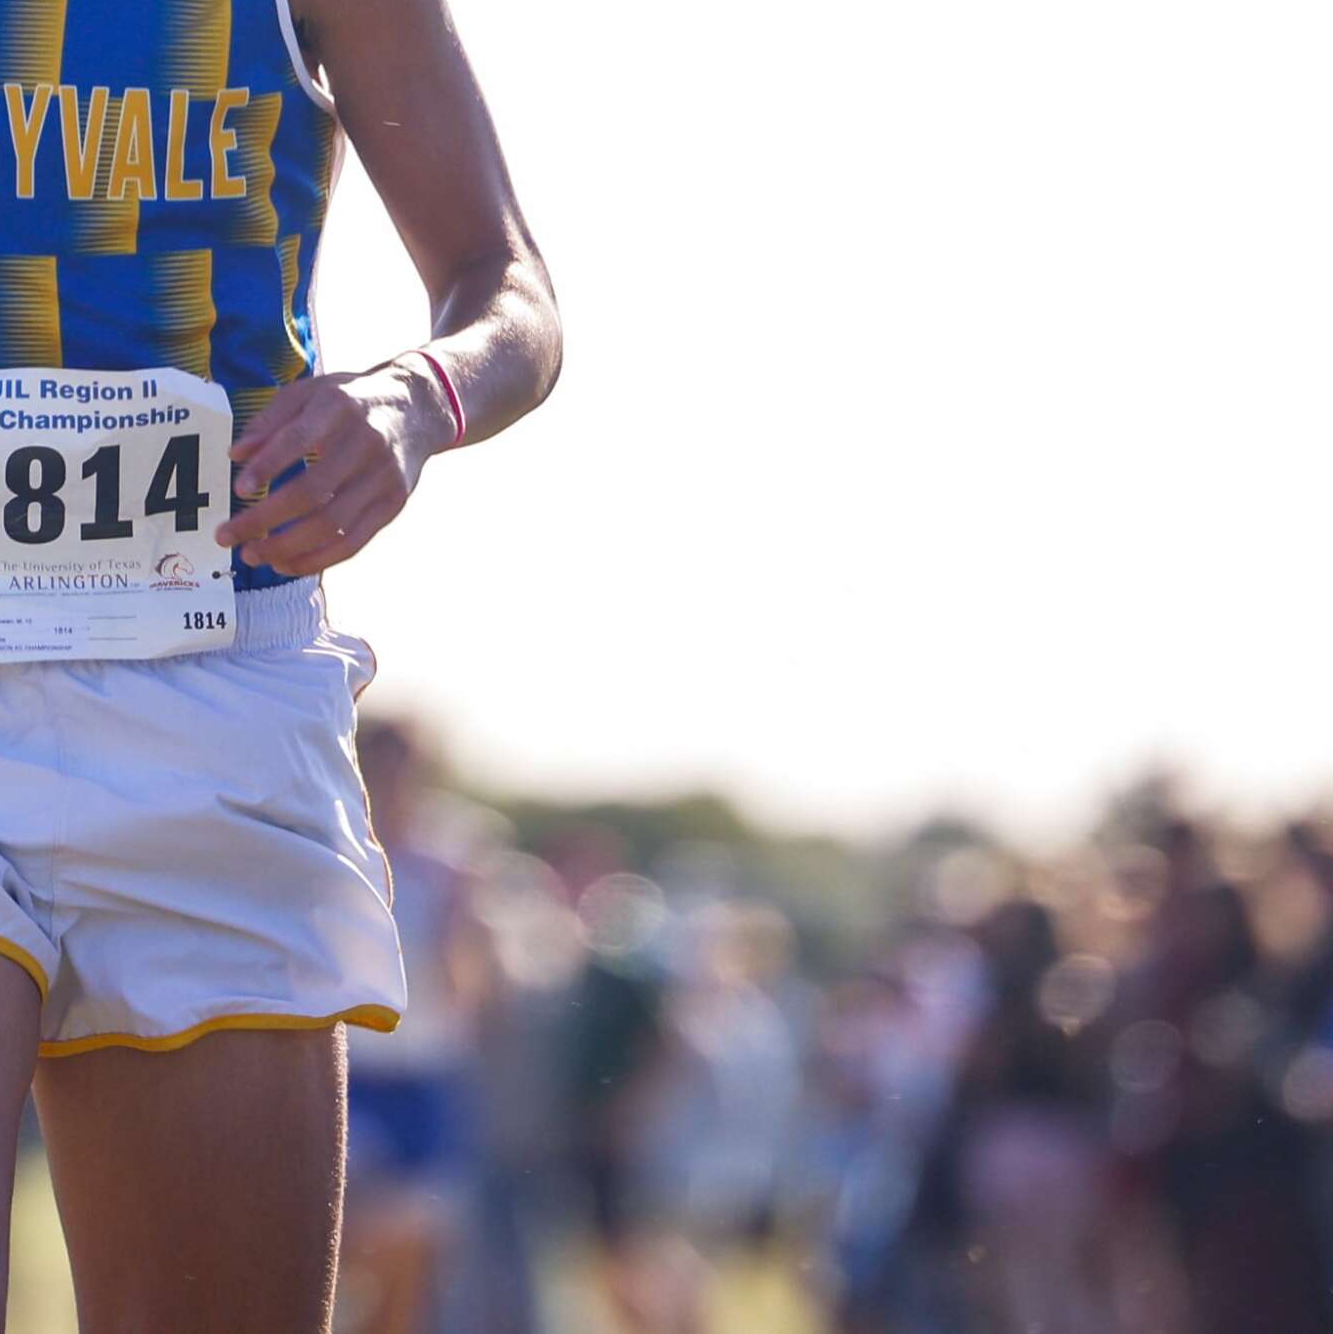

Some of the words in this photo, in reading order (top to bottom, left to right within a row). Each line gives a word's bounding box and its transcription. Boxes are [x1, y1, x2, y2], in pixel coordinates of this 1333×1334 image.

[39, 379, 133, 403] Region
[22, 560, 85, 573] University
[89, 559, 102, 571] of
[108, 558, 142, 570] Texas
[9, 573, 129, 591] ARLINGTON
[183, 612, 227, 630] 1814
